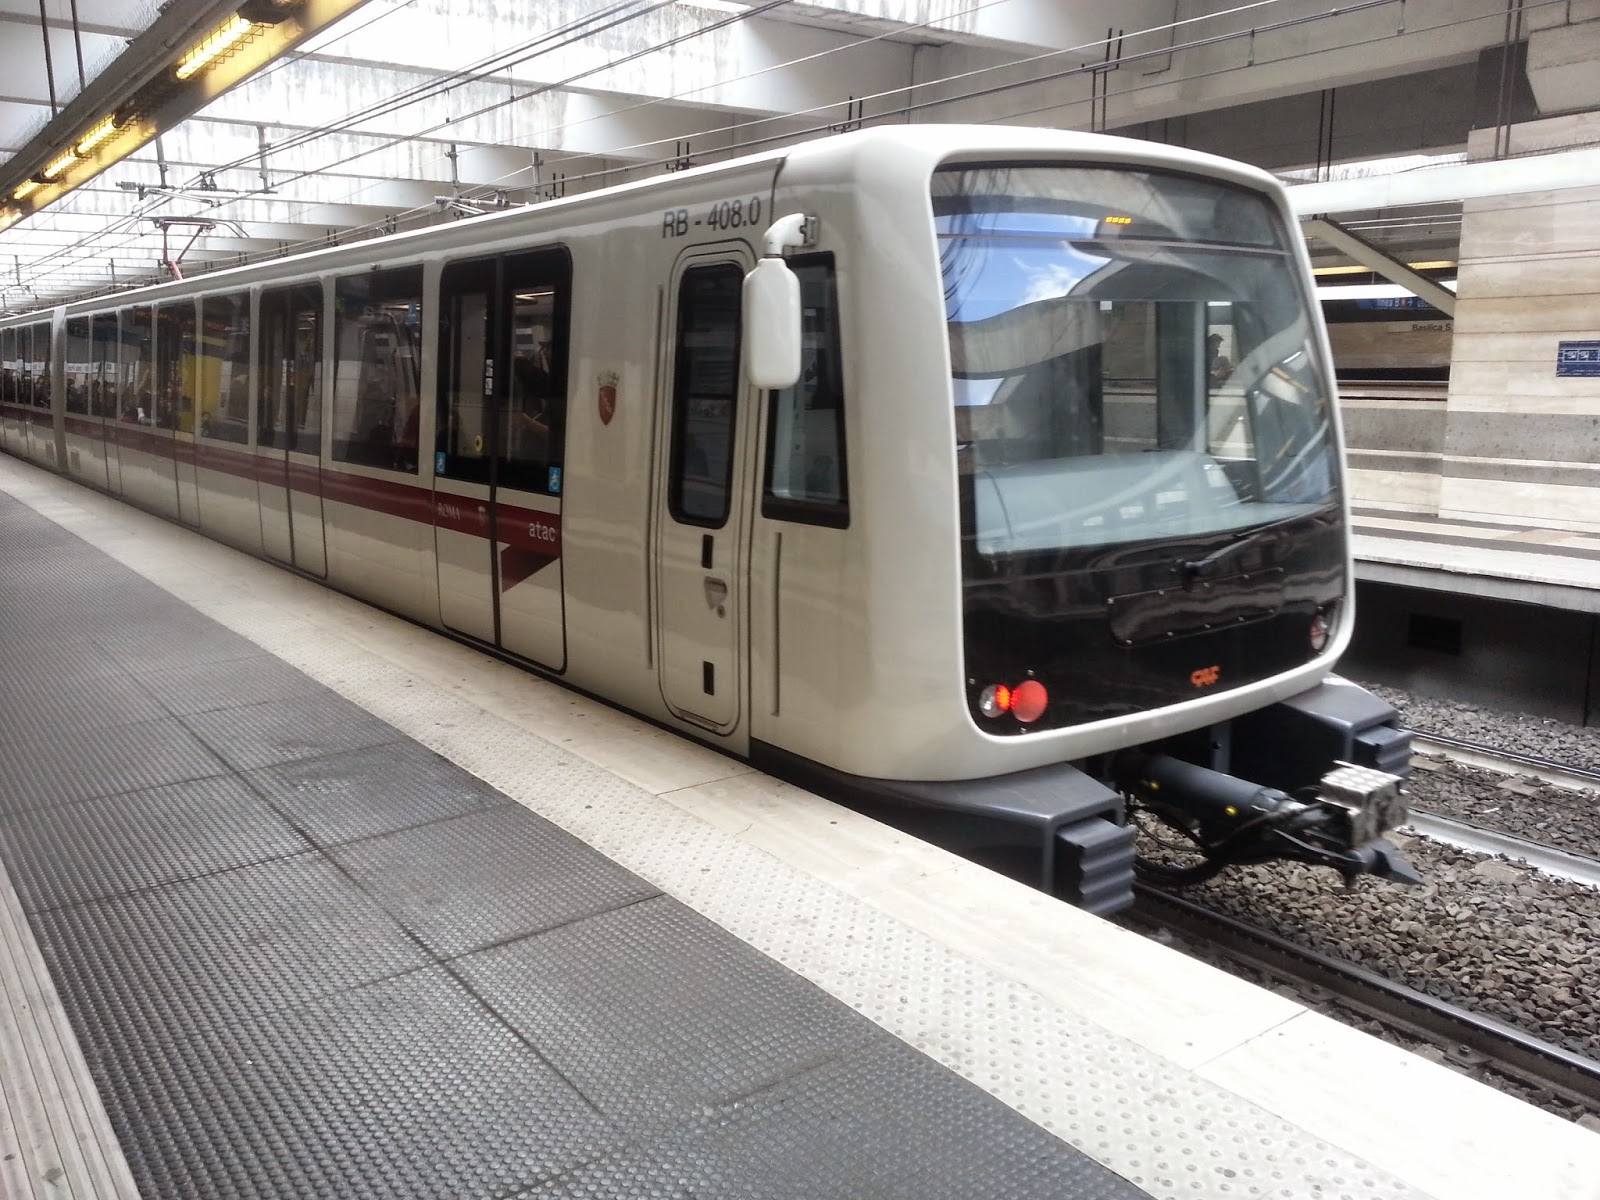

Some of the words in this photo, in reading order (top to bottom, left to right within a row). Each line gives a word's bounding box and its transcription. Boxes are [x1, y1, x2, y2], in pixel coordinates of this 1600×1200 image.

[662, 209, 689, 239] RB
[707, 195, 762, 231] 408.0
[1412, 324, 1443, 332] Basilica
[438, 502, 461, 520] ROMA
[529, 521, 557, 542] atac
